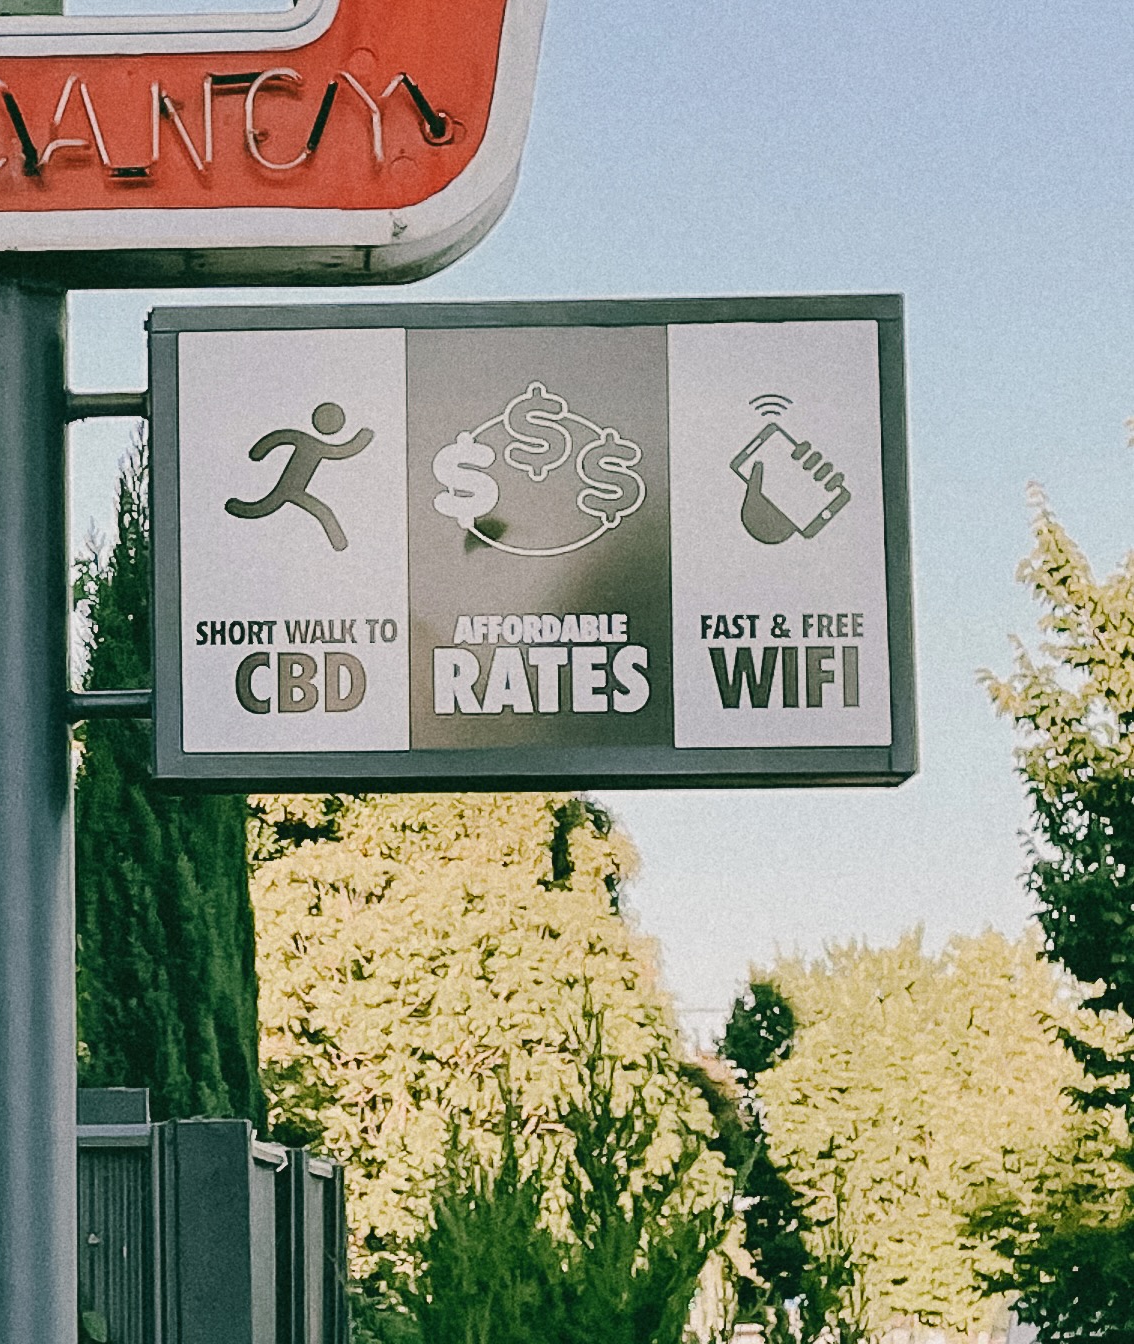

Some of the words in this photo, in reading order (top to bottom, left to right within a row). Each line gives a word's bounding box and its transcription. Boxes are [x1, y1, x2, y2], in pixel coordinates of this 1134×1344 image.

[195, 620, 277, 646] SHORT
[285, 618, 358, 645] WALK
[365, 618, 398, 644] TO
[454, 613, 629, 644] AFFORDABLE
[700, 615, 761, 640] FAST
[770, 614, 792, 639] &
[801, 613, 864, 639] FREE
[235, 651, 367, 714] CBD
[433, 645, 651, 715] RATES
[708, 646, 860, 709] WIFI
